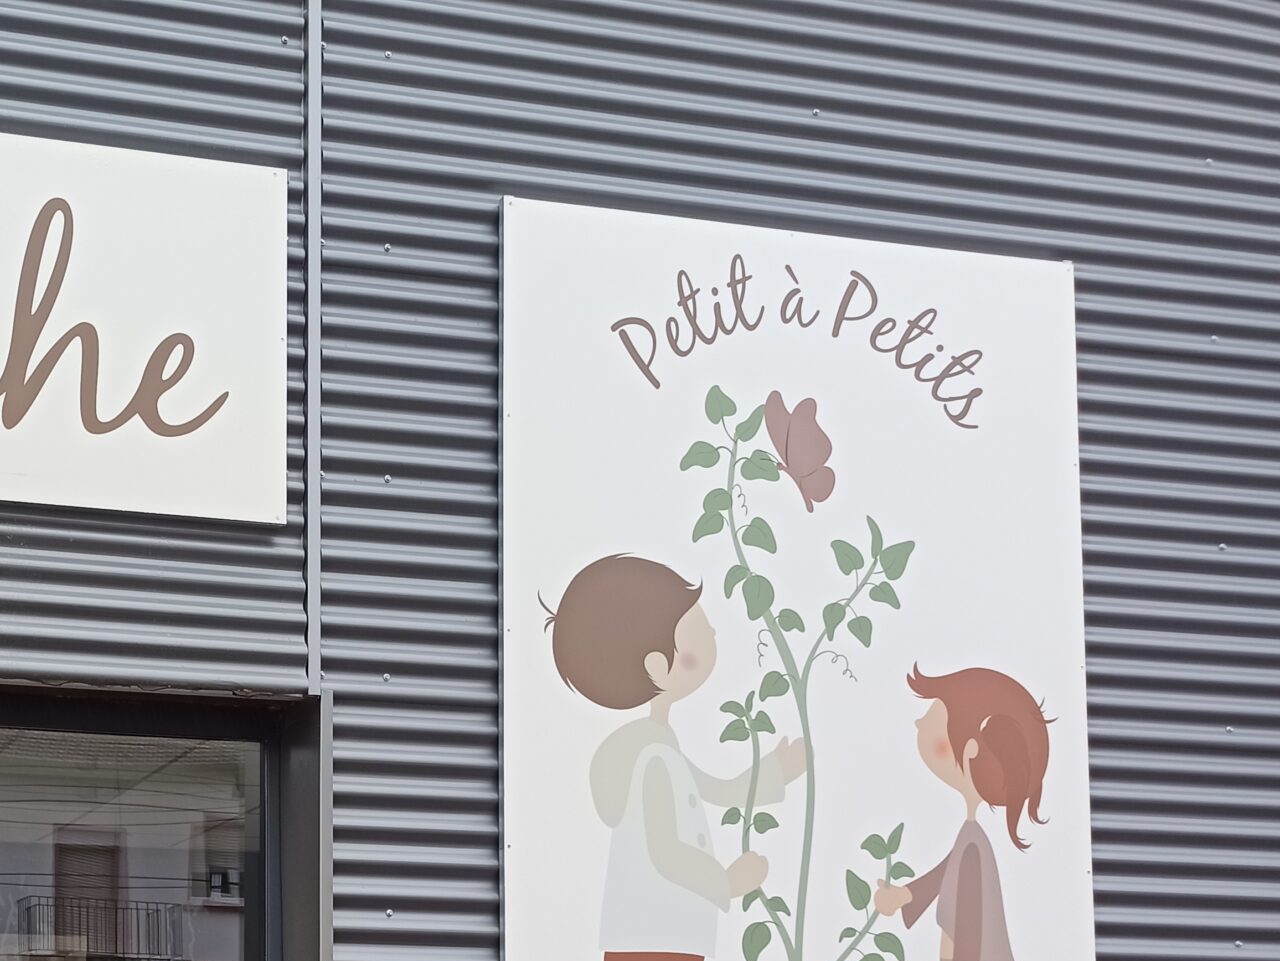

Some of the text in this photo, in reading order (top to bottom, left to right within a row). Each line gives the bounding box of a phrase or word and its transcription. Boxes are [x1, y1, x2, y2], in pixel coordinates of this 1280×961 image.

[611, 254, 984, 429] Petit à Petits
